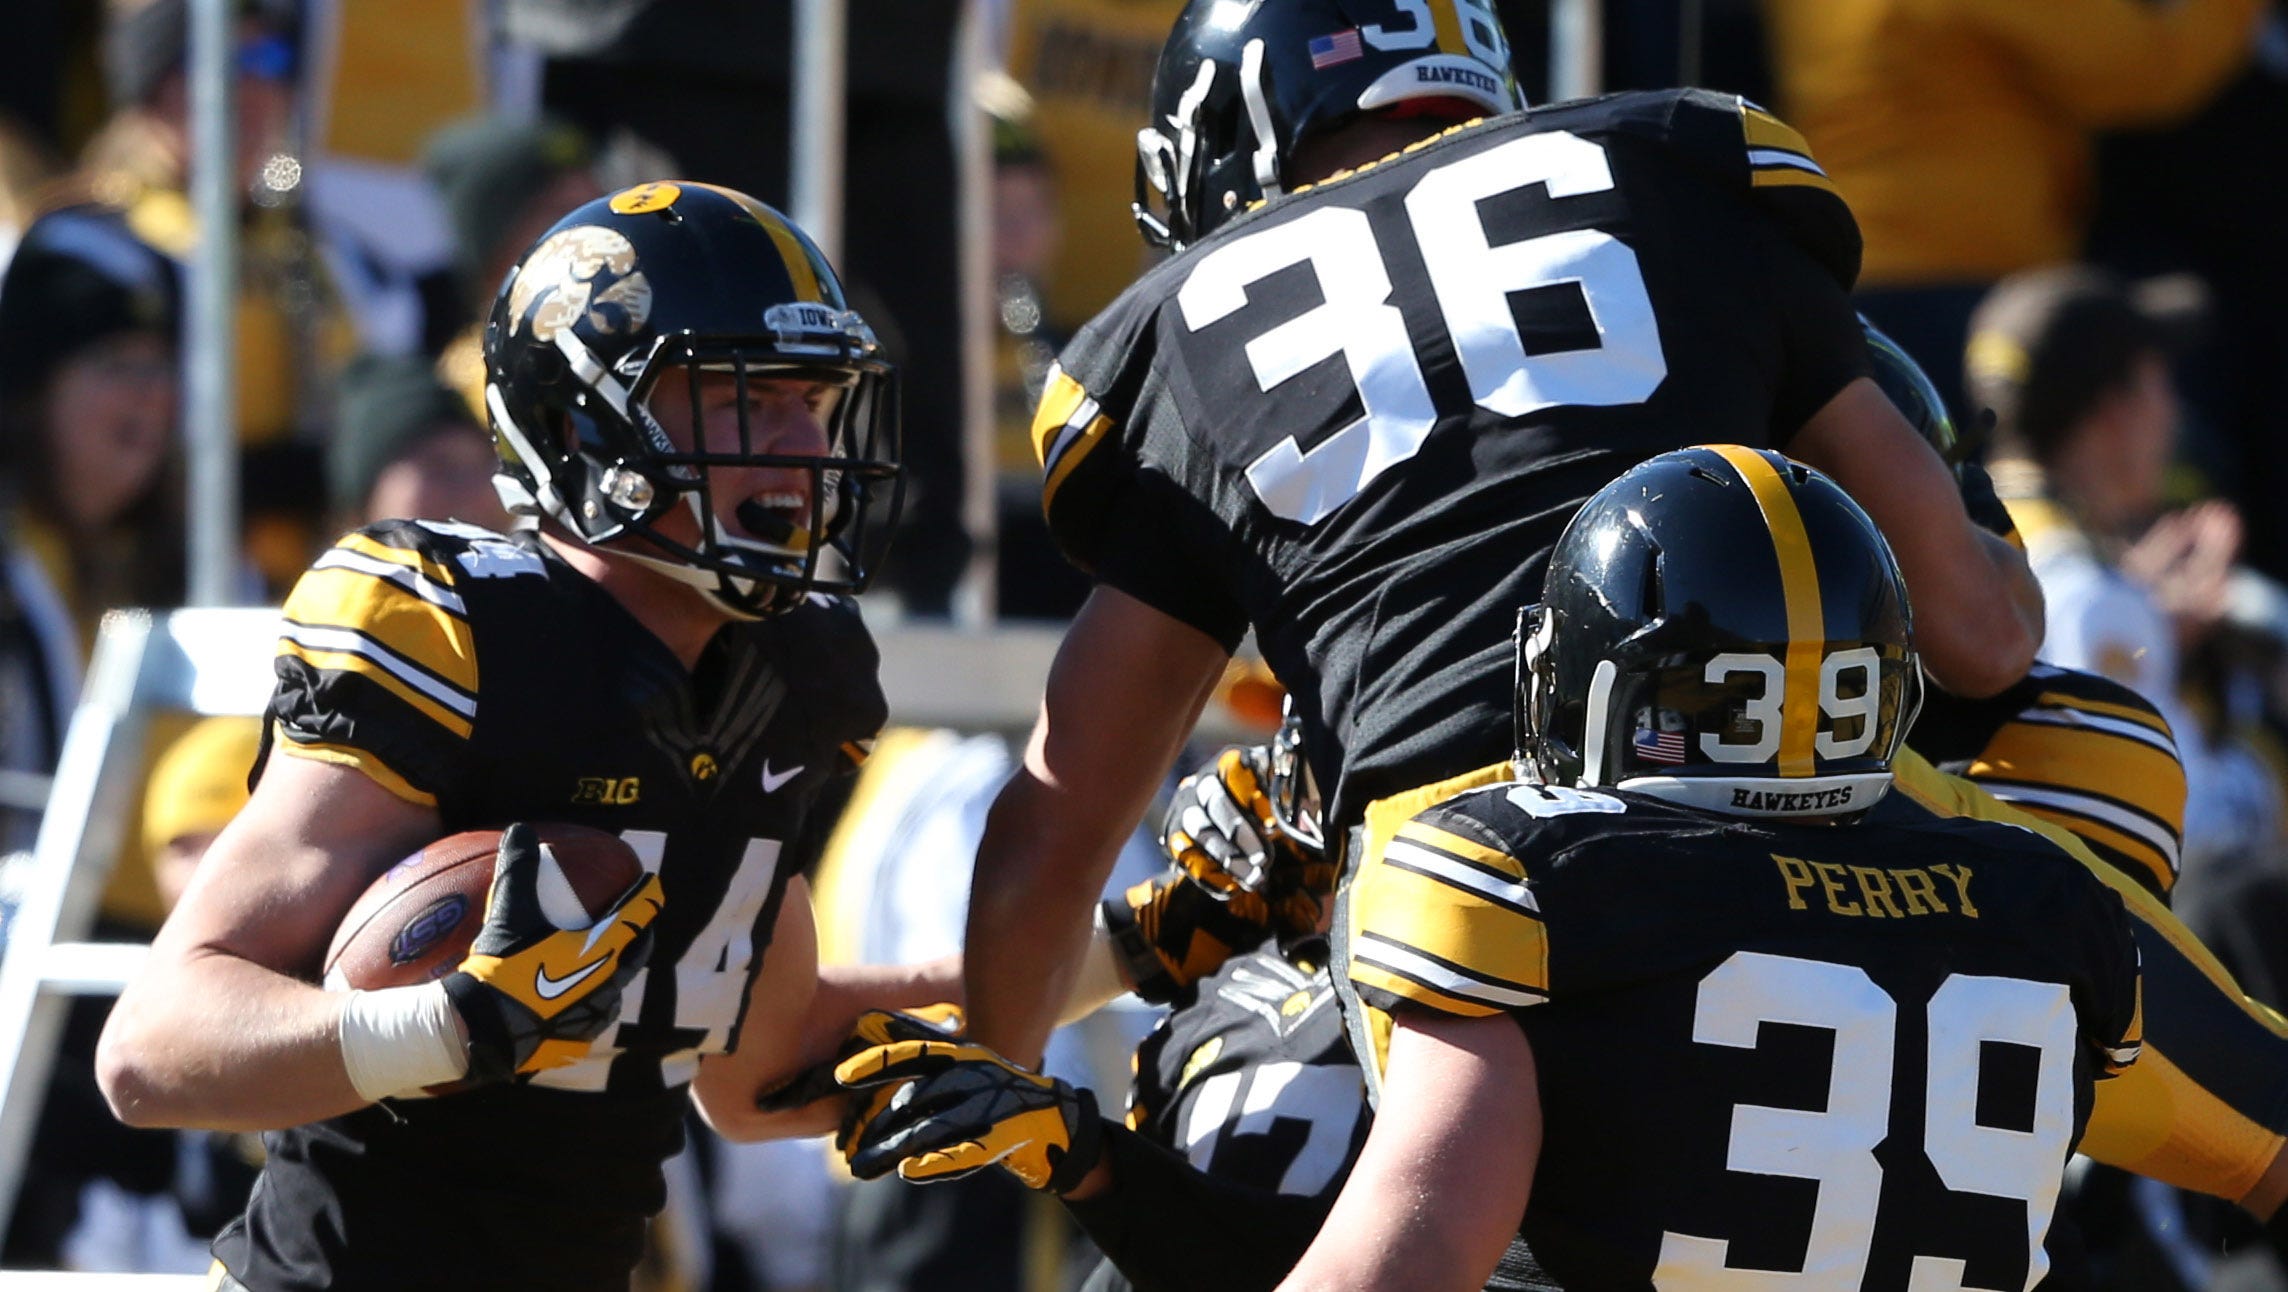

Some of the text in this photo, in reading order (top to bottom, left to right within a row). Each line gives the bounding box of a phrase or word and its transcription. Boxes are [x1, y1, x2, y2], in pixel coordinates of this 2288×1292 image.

[1416, 64, 1498, 94] HAWKEYES
[1177, 130, 1668, 526] 36
[1700, 647, 1881, 764] 39
[1730, 786, 1853, 812] HAWKEYES
[1770, 853, 1979, 919] PERRY
[1651, 951, 2078, 1292] 39
